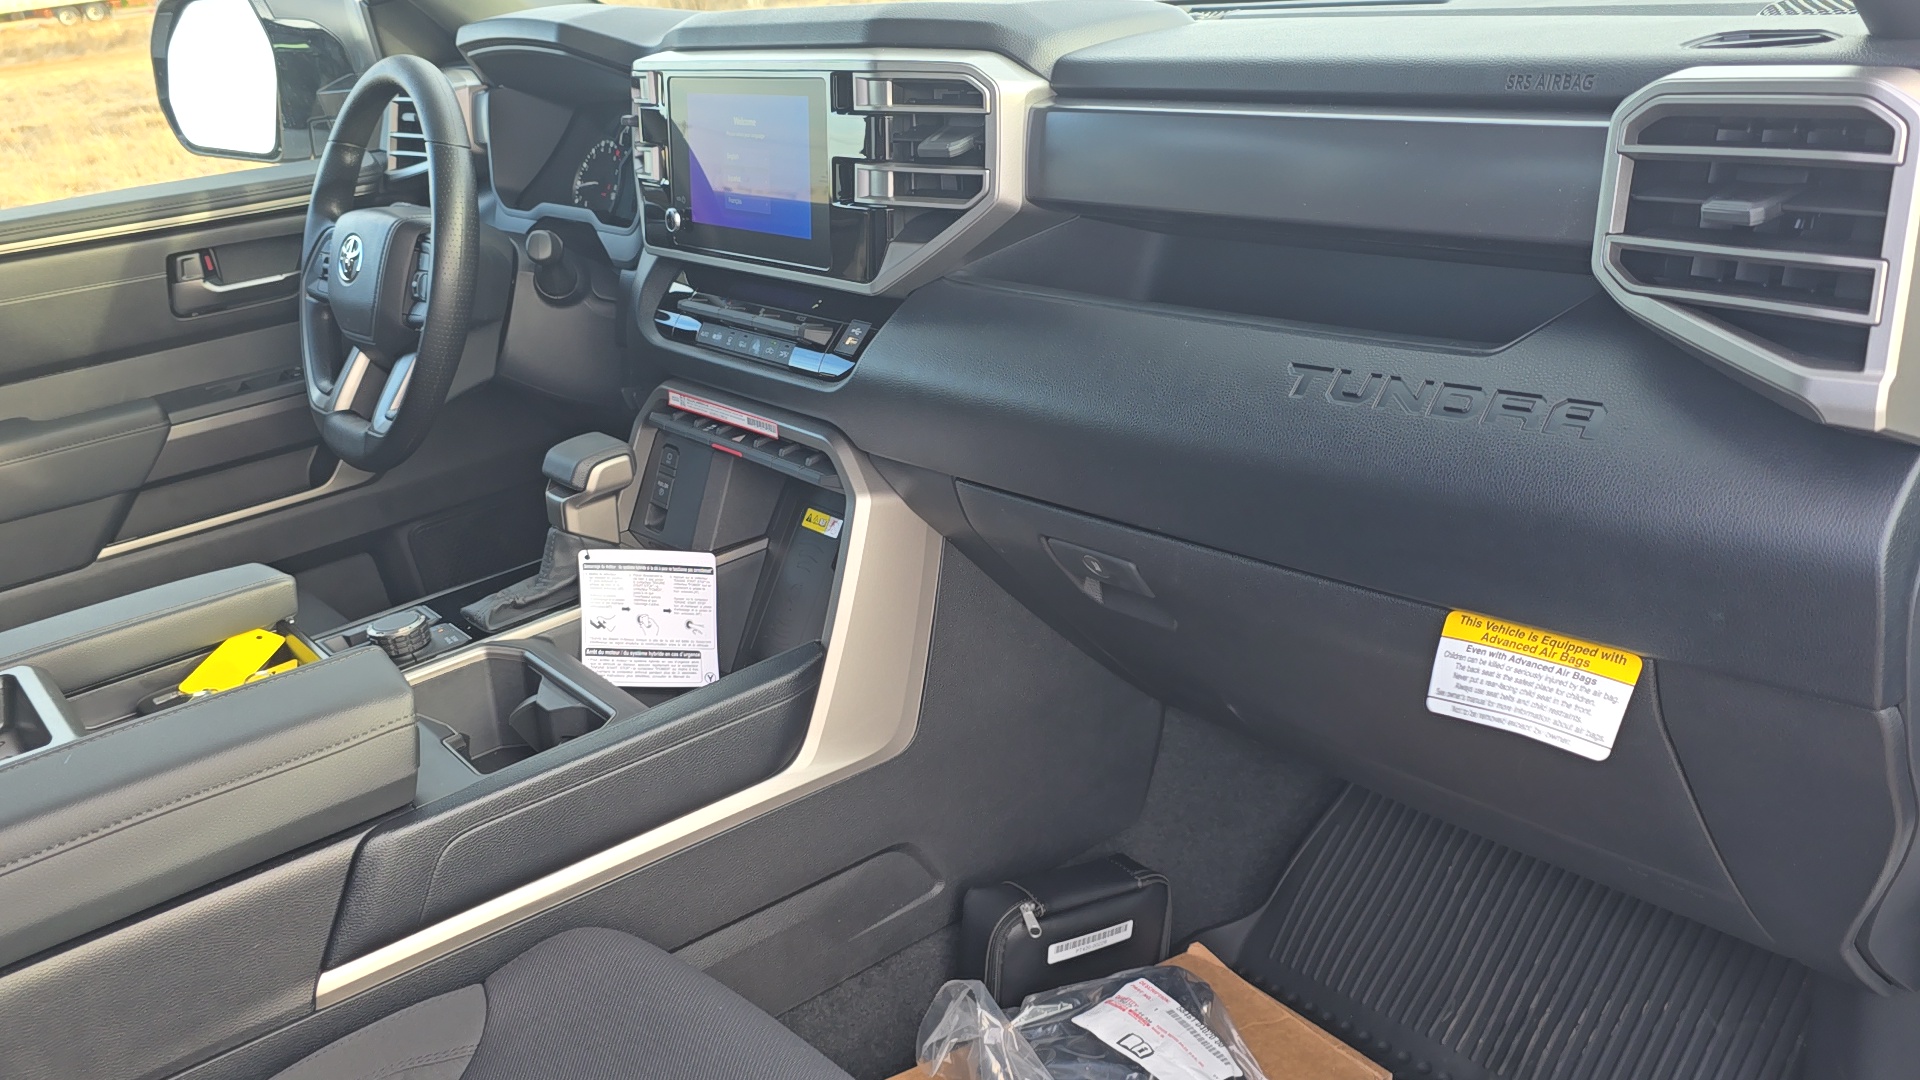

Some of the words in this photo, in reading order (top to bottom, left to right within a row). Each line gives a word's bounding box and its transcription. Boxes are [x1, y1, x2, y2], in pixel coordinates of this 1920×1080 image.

[1505, 74, 1532, 91] SRS
[1534, 73, 1595, 92] AIRBAG
[1287, 361, 1609, 441] TUNDRA
[1460, 615, 1482, 628] This
[1485, 621, 1525, 638] Vehicle
[1528, 632, 1538, 641] is
[1541, 635, 1597, 657] Equipped
[1600, 650, 1627, 664] with
[1481, 631, 1537, 653] Advanced
[1539, 647, 1557, 658] Air
[1559, 652, 1590, 669] Bags
[1443, 650, 1466, 661] Children
[1487, 660, 1504, 670] killed
[1512, 666, 1543, 681] seriously
[1544, 675, 1568, 687] injured
[1568, 681, 1578, 691] by
[1578, 684, 1591, 693] the
[1591, 688, 1603, 697] air
[1466, 645, 1486, 655] Even
[1488, 650, 1506, 660] with
[1508, 655, 1554, 672] Advanced
[1555, 668, 1570, 676] Air
[1571, 672, 1597, 686] Bags
[1480, 668, 1495, 677] seat
[1502, 673, 1513, 681] the
